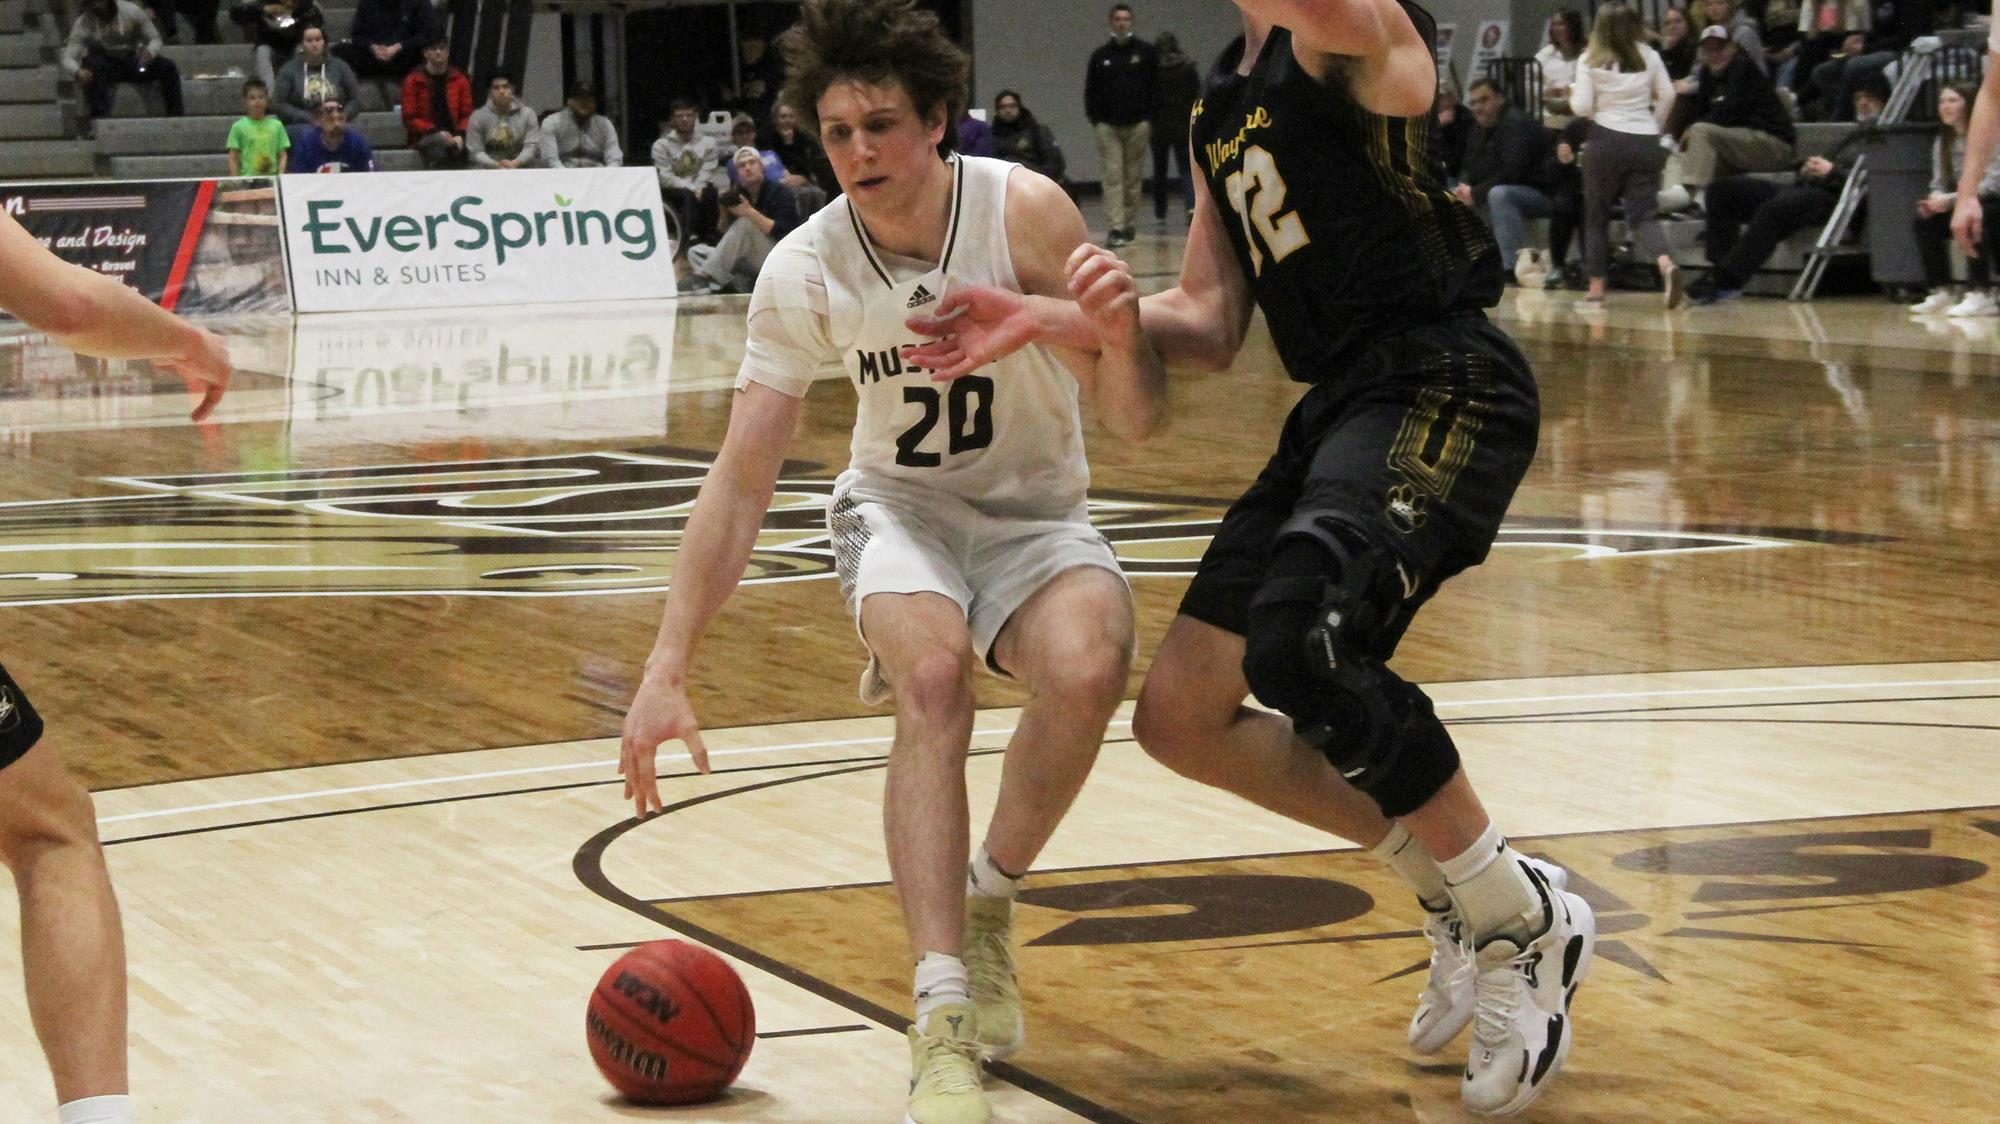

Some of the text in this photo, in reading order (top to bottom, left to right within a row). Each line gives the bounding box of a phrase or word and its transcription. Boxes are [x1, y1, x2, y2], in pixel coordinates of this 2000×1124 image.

[56, 226, 91, 248] and
[92, 225, 147, 255] Design
[301, 194, 657, 266] EverSpring
[315, 263, 487, 287] INN & SUITES
[906, 294, 937, 309] adidas
[895, 374, 995, 468] 20
